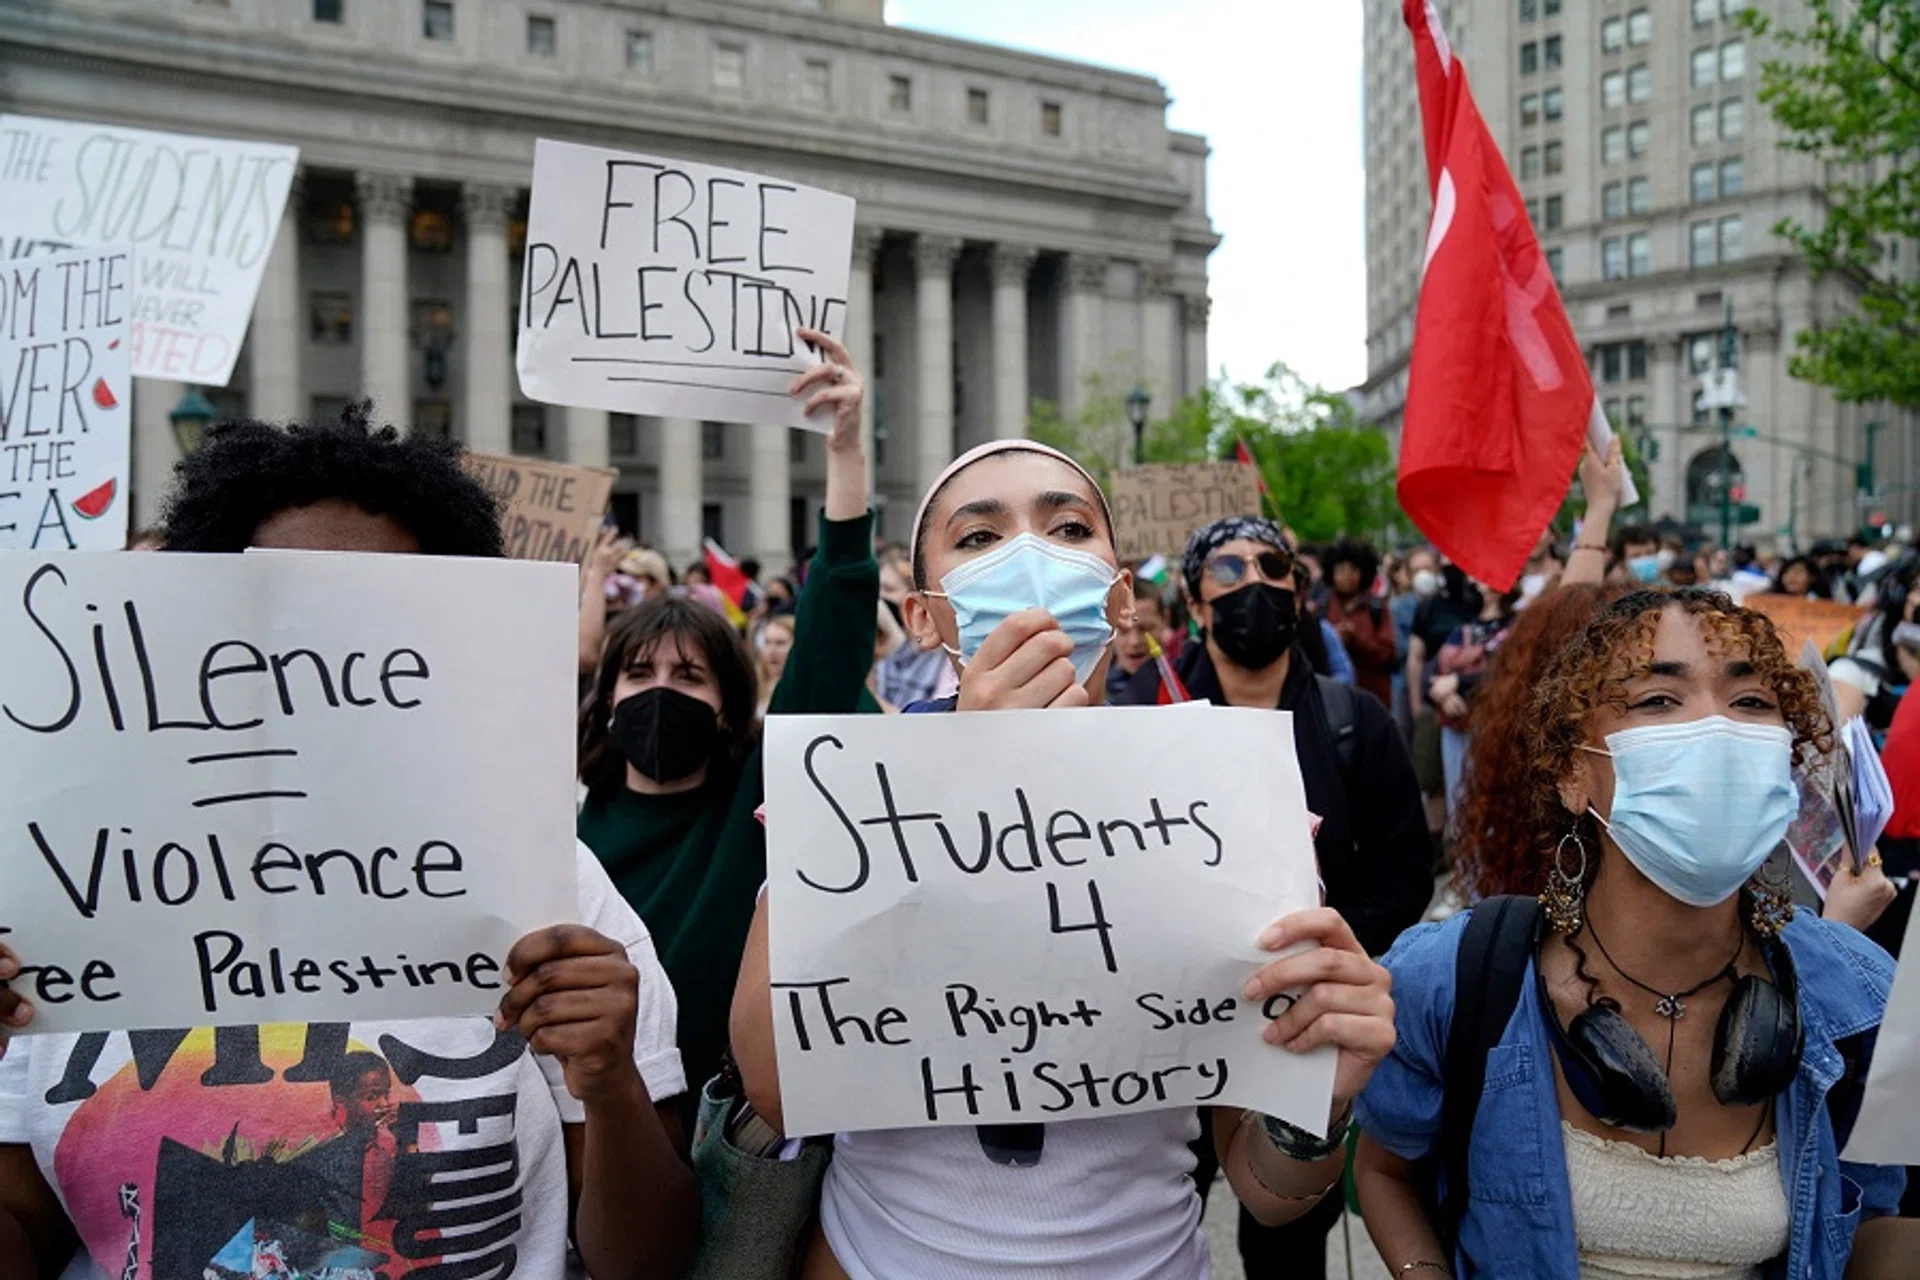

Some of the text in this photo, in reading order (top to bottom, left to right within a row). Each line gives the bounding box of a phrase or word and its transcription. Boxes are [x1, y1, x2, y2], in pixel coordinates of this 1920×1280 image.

[3, 129, 292, 268] THE STUDENTS
[602, 160, 814, 274] FREE
[56, 254, 126, 332] THE
[141, 256, 222, 296] WILL
[4, 441, 76, 481] THE
[530, 470, 577, 513] THE
[796, 734, 1223, 894] Students
[27, 821, 468, 918] Violence
[1046, 879, 1118, 973] 4
[194, 930, 500, 1012] Palestine
[771, 977, 912, 1051] The
[945, 983, 1102, 1053] Right
